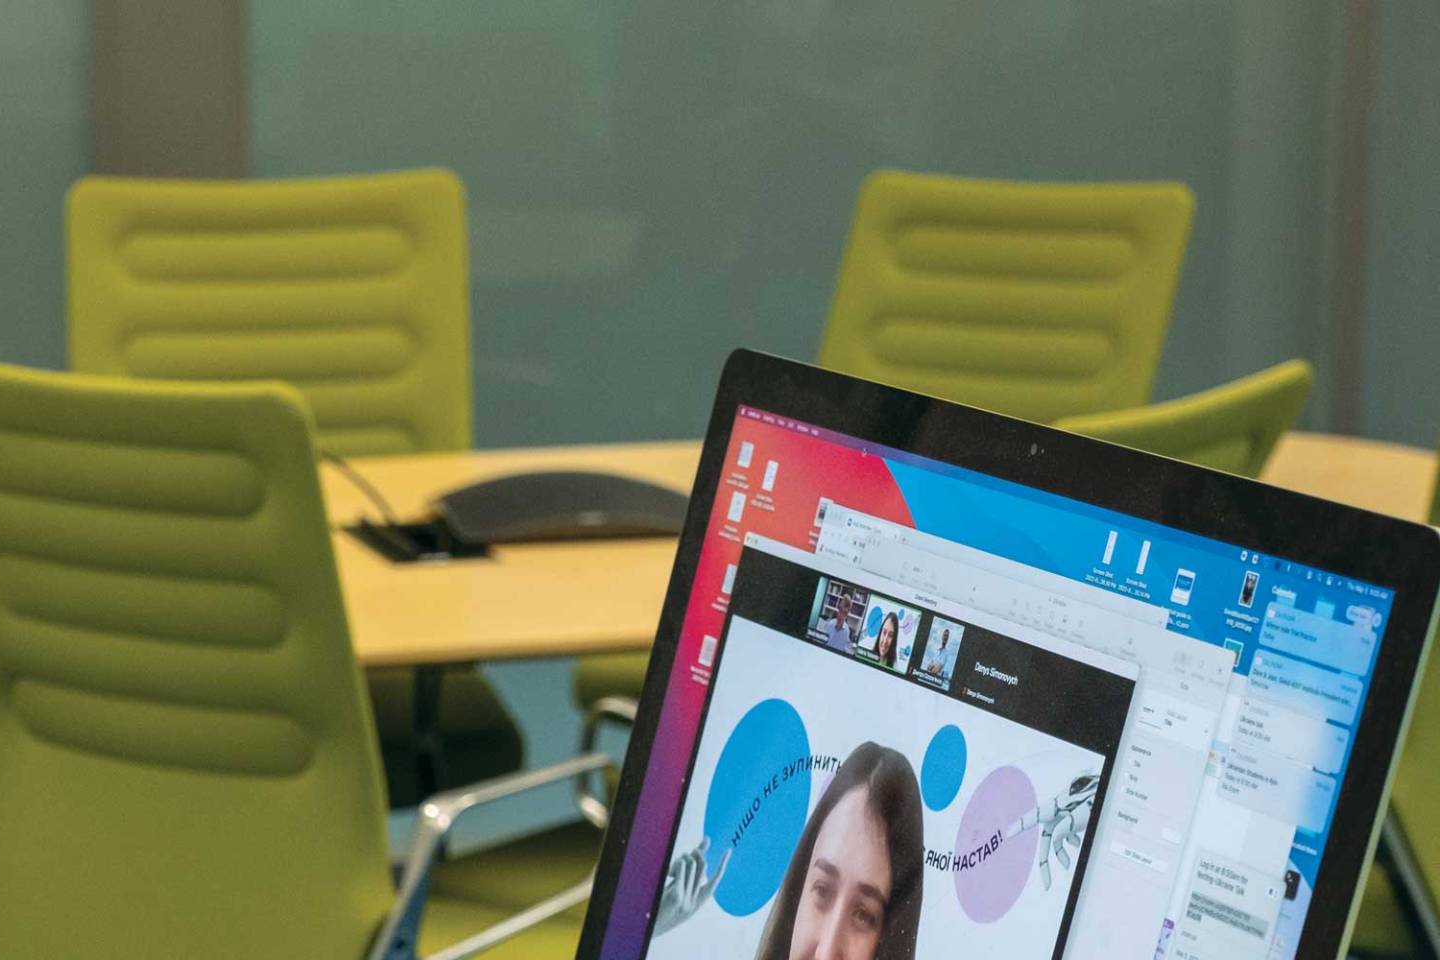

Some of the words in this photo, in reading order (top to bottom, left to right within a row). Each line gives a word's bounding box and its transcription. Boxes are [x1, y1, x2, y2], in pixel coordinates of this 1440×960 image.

[763, 775, 780, 799] НЕ
[925, 850, 953, 873] ЯКОЇ
[952, 829, 1004, 873] НАСТАВ!
